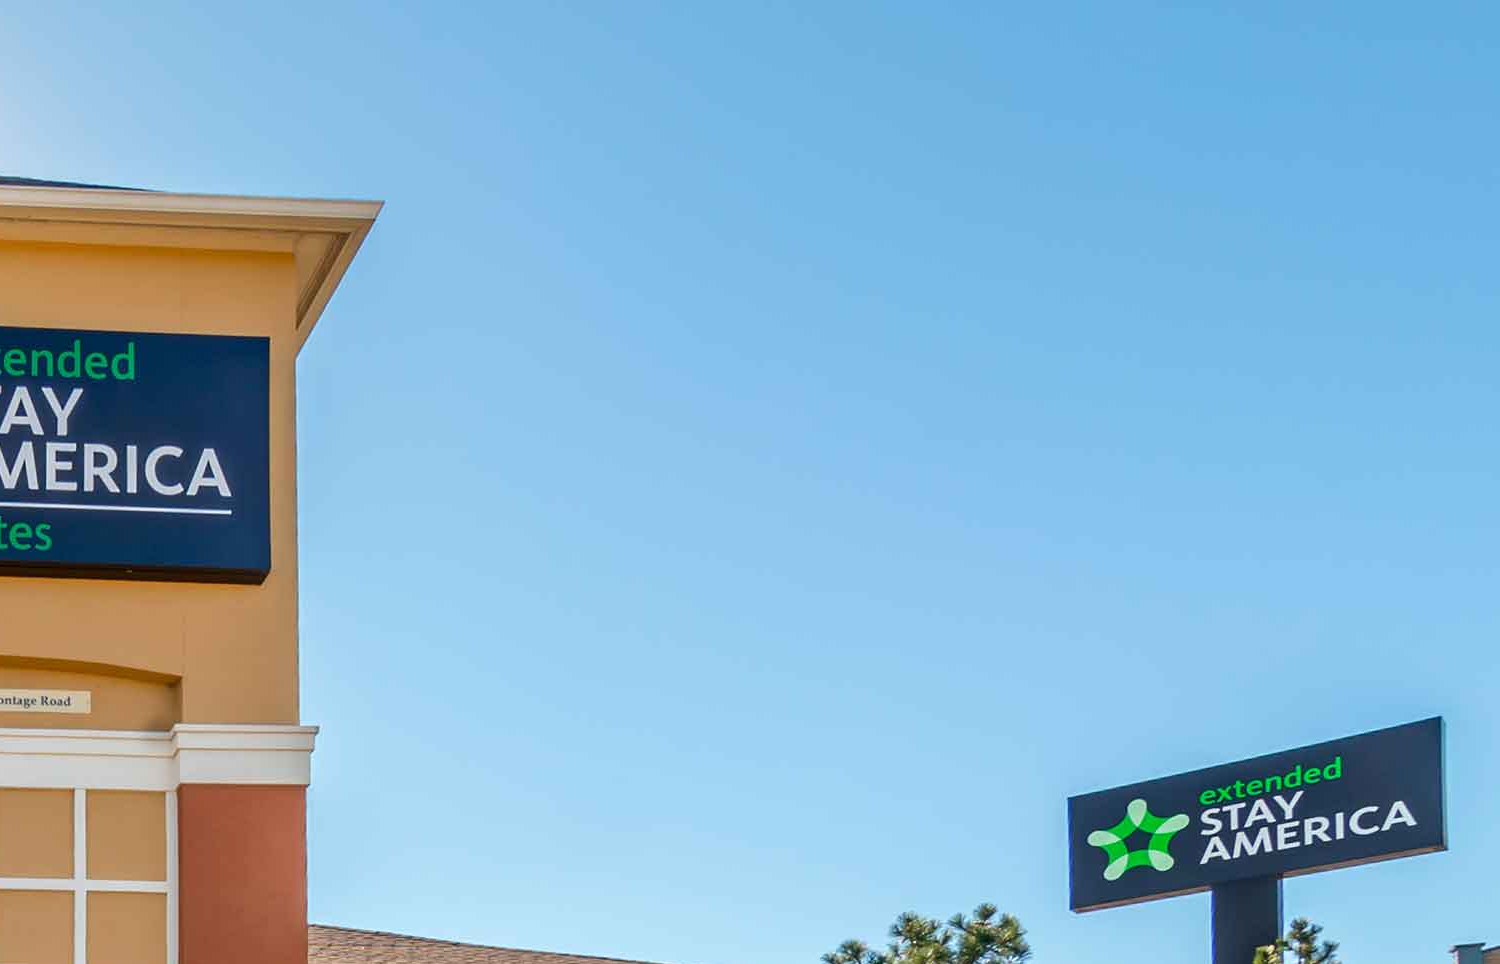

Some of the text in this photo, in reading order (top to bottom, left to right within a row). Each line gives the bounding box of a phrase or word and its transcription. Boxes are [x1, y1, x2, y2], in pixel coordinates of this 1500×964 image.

[40, 696, 72, 707] Road
[1199, 756, 1342, 806] extended
[1199, 800, 1418, 865] AMERICA
[1200, 790, 1304, 836] STAY
